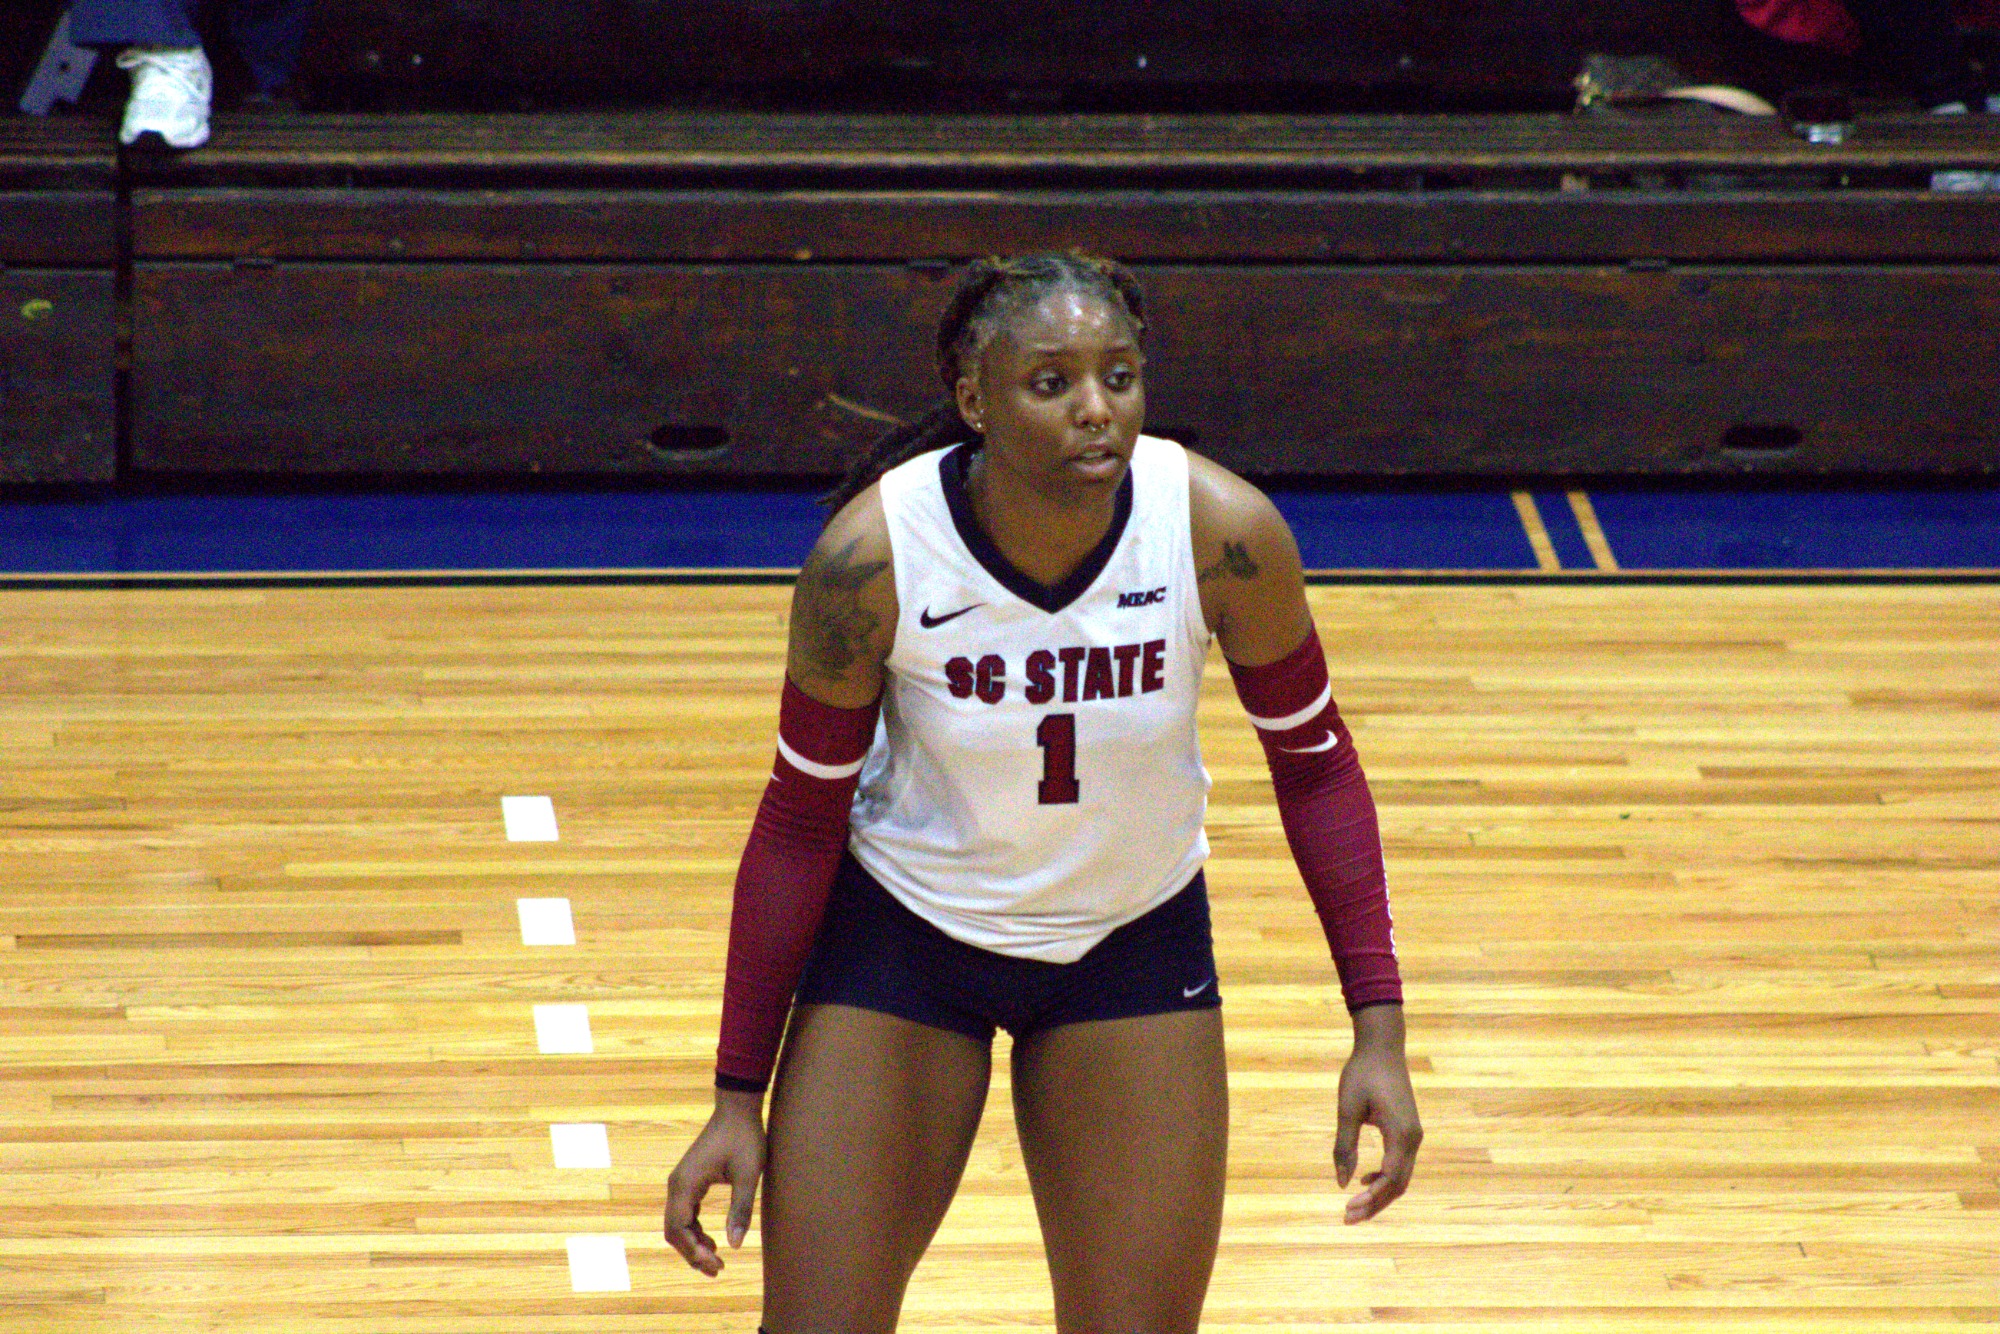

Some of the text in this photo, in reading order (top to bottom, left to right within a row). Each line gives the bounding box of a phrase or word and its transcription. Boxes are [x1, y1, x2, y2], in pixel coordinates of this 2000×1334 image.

[1117, 586, 1166, 609] MEAC
[945, 639, 1166, 705] SC STATE
[1036, 713, 1080, 805] 1
